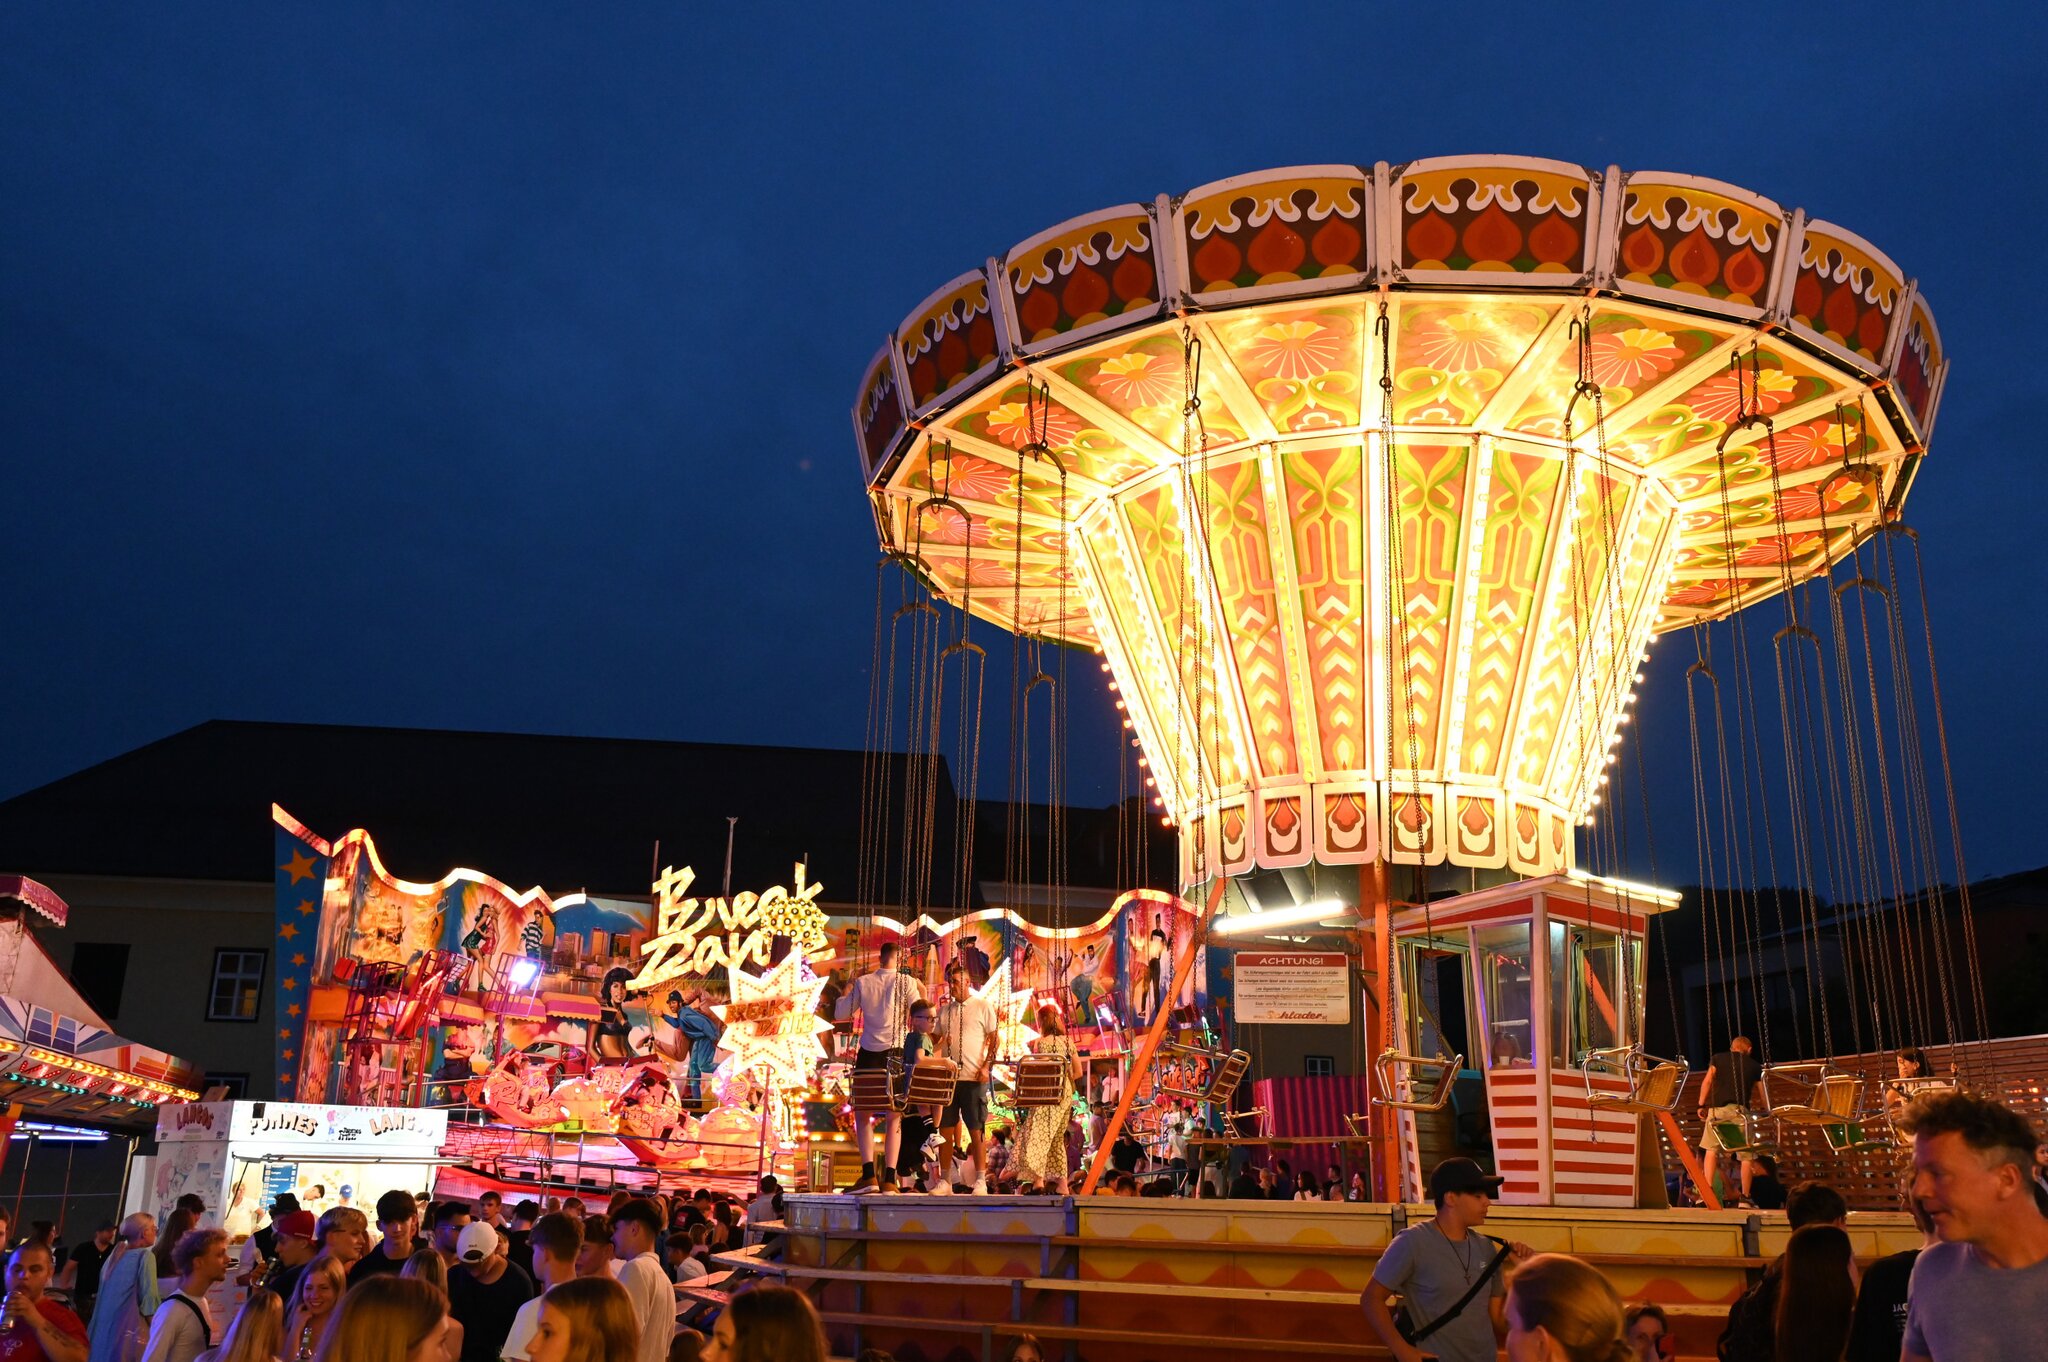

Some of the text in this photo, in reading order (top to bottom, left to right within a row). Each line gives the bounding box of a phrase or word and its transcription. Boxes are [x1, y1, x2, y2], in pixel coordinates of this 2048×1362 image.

[1259, 957, 1324, 965] ACHTUNG!
[724, 999, 785, 1025] BREAK
[369, 1111, 434, 1137] LANG
